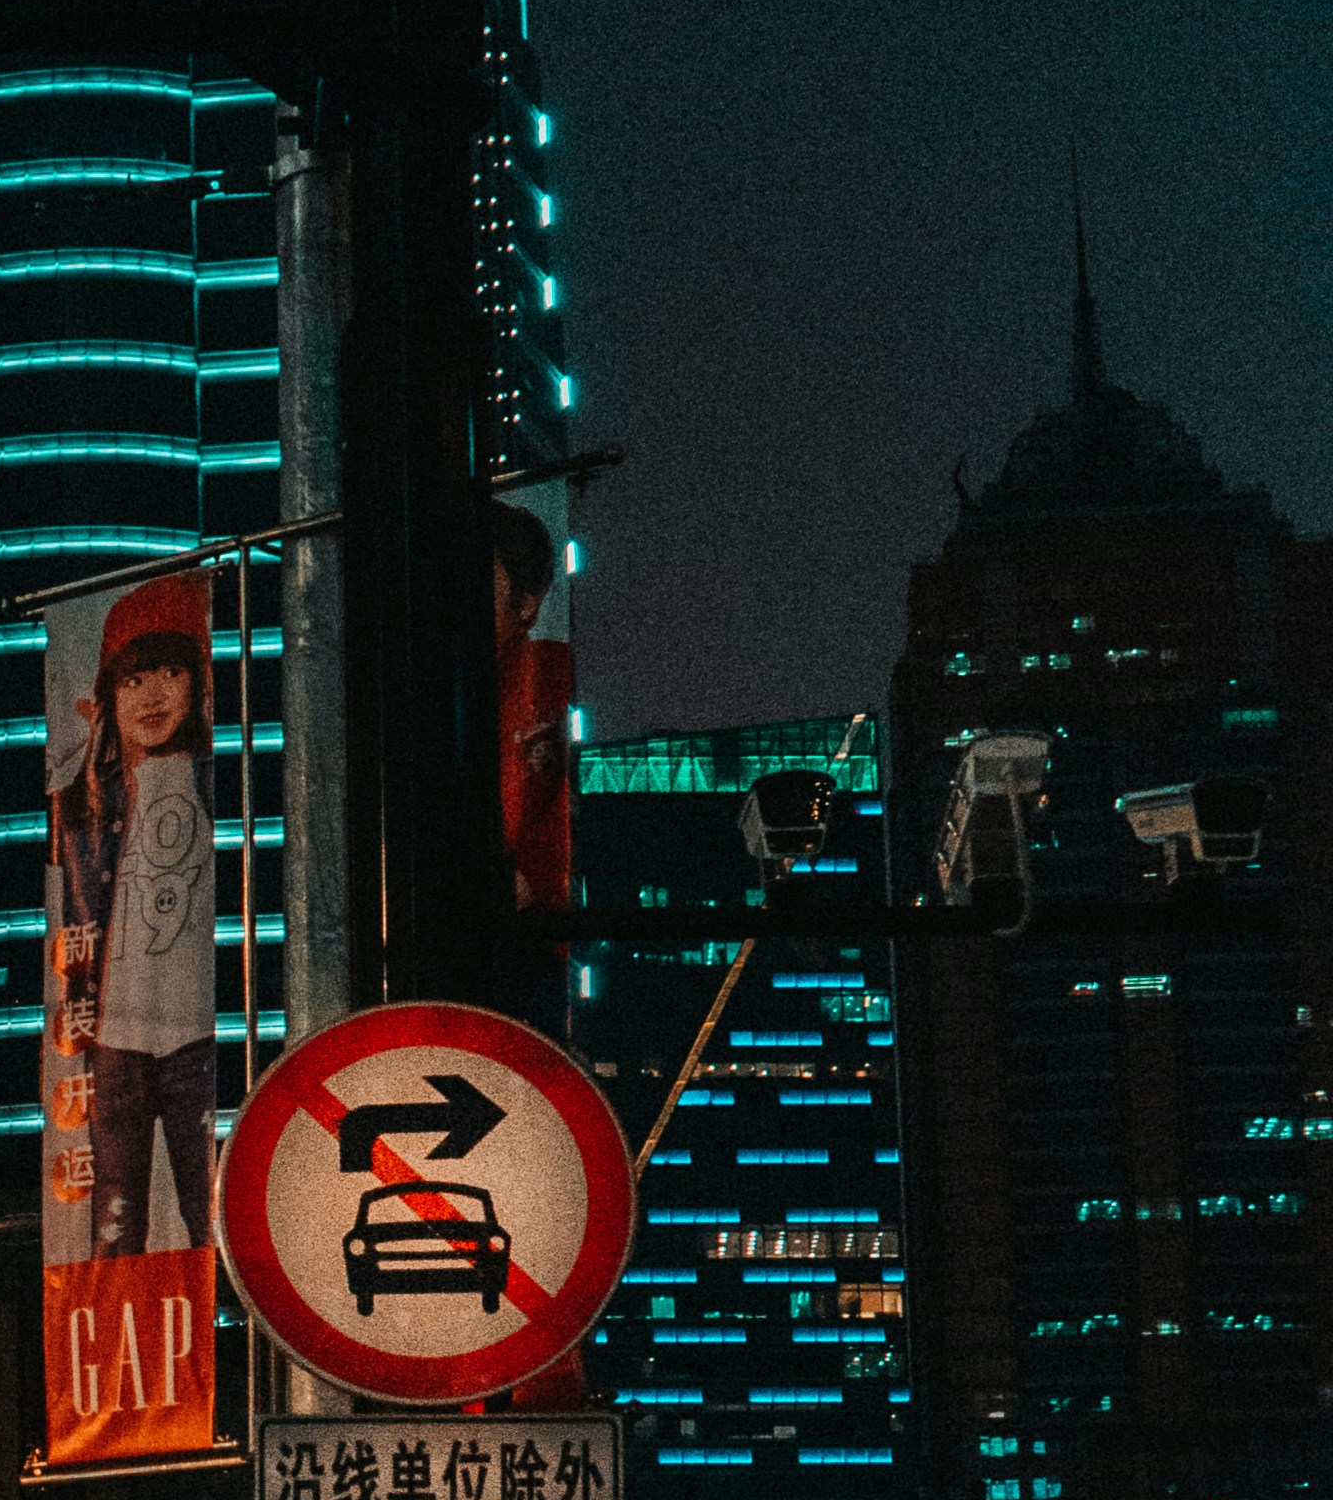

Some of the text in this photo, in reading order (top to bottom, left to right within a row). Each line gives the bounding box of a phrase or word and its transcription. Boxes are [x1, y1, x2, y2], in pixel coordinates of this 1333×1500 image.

[61, 920, 100, 1188] 新装开运
[69, 1296, 193, 1417] GAP
